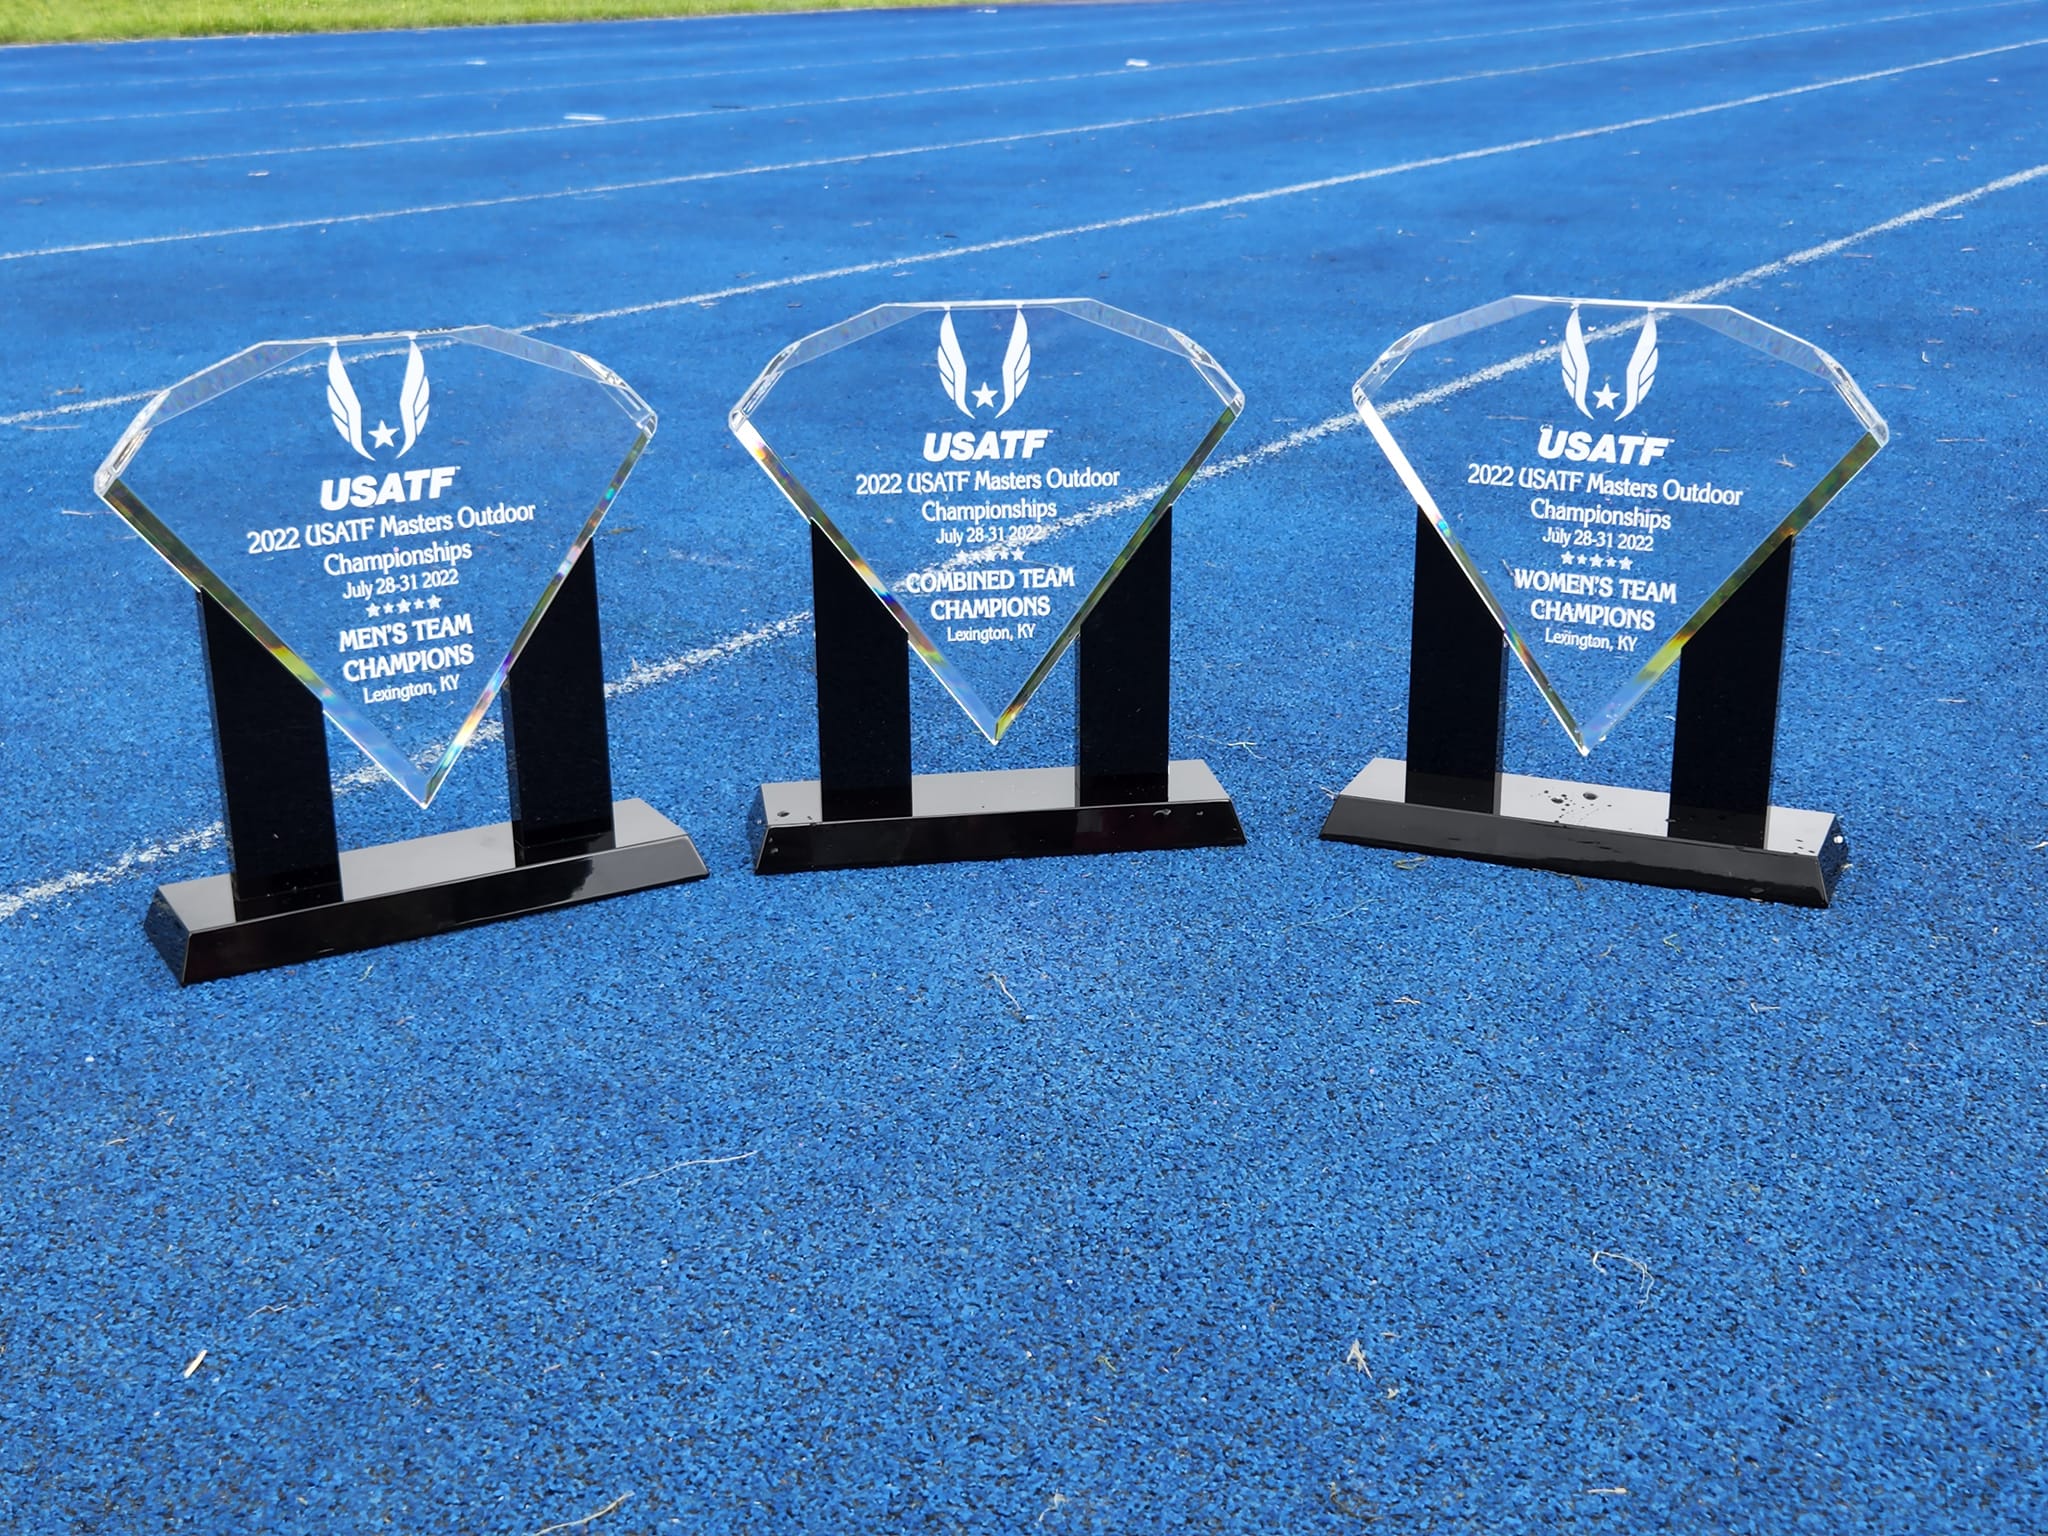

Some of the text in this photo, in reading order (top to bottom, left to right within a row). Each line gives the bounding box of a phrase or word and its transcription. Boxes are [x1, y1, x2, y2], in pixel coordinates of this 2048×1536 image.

[923, 430, 1048, 462] USATF
[1537, 428, 1669, 466] USATF
[320, 466, 456, 511] USATF
[856, 468, 1120, 494] 2022 USATF Masters Outdoor
[1468, 464, 1743, 505] 2022 USATF Masters Outdoor
[922, 498, 1057, 526] Championships
[1531, 498, 1671, 532] Championships
[247, 503, 536, 554] 2022 USATF Masters Outdoor
[936, 526, 1042, 547] July 28-31 2022
[1543, 527, 1654, 551] July 28-31 2022
[324, 541, 472, 575] Championships
[343, 569, 459, 599] July 28-31 2022
[907, 568, 1074, 593] COMBINED TEAM
[1619, 579, 1677, 603] TEAM
[931, 596, 1050, 620] CHAMPIONS
[1531, 600, 1655, 630] CHAMPIONS
[412, 614, 473, 641] TEAM
[948, 623, 1036, 644] Lexington, KY
[1545, 628, 1637, 652] Lexington, KY
[343, 644, 474, 682] CHAMPIONS
[363, 674, 460, 703] Lexington, KY
